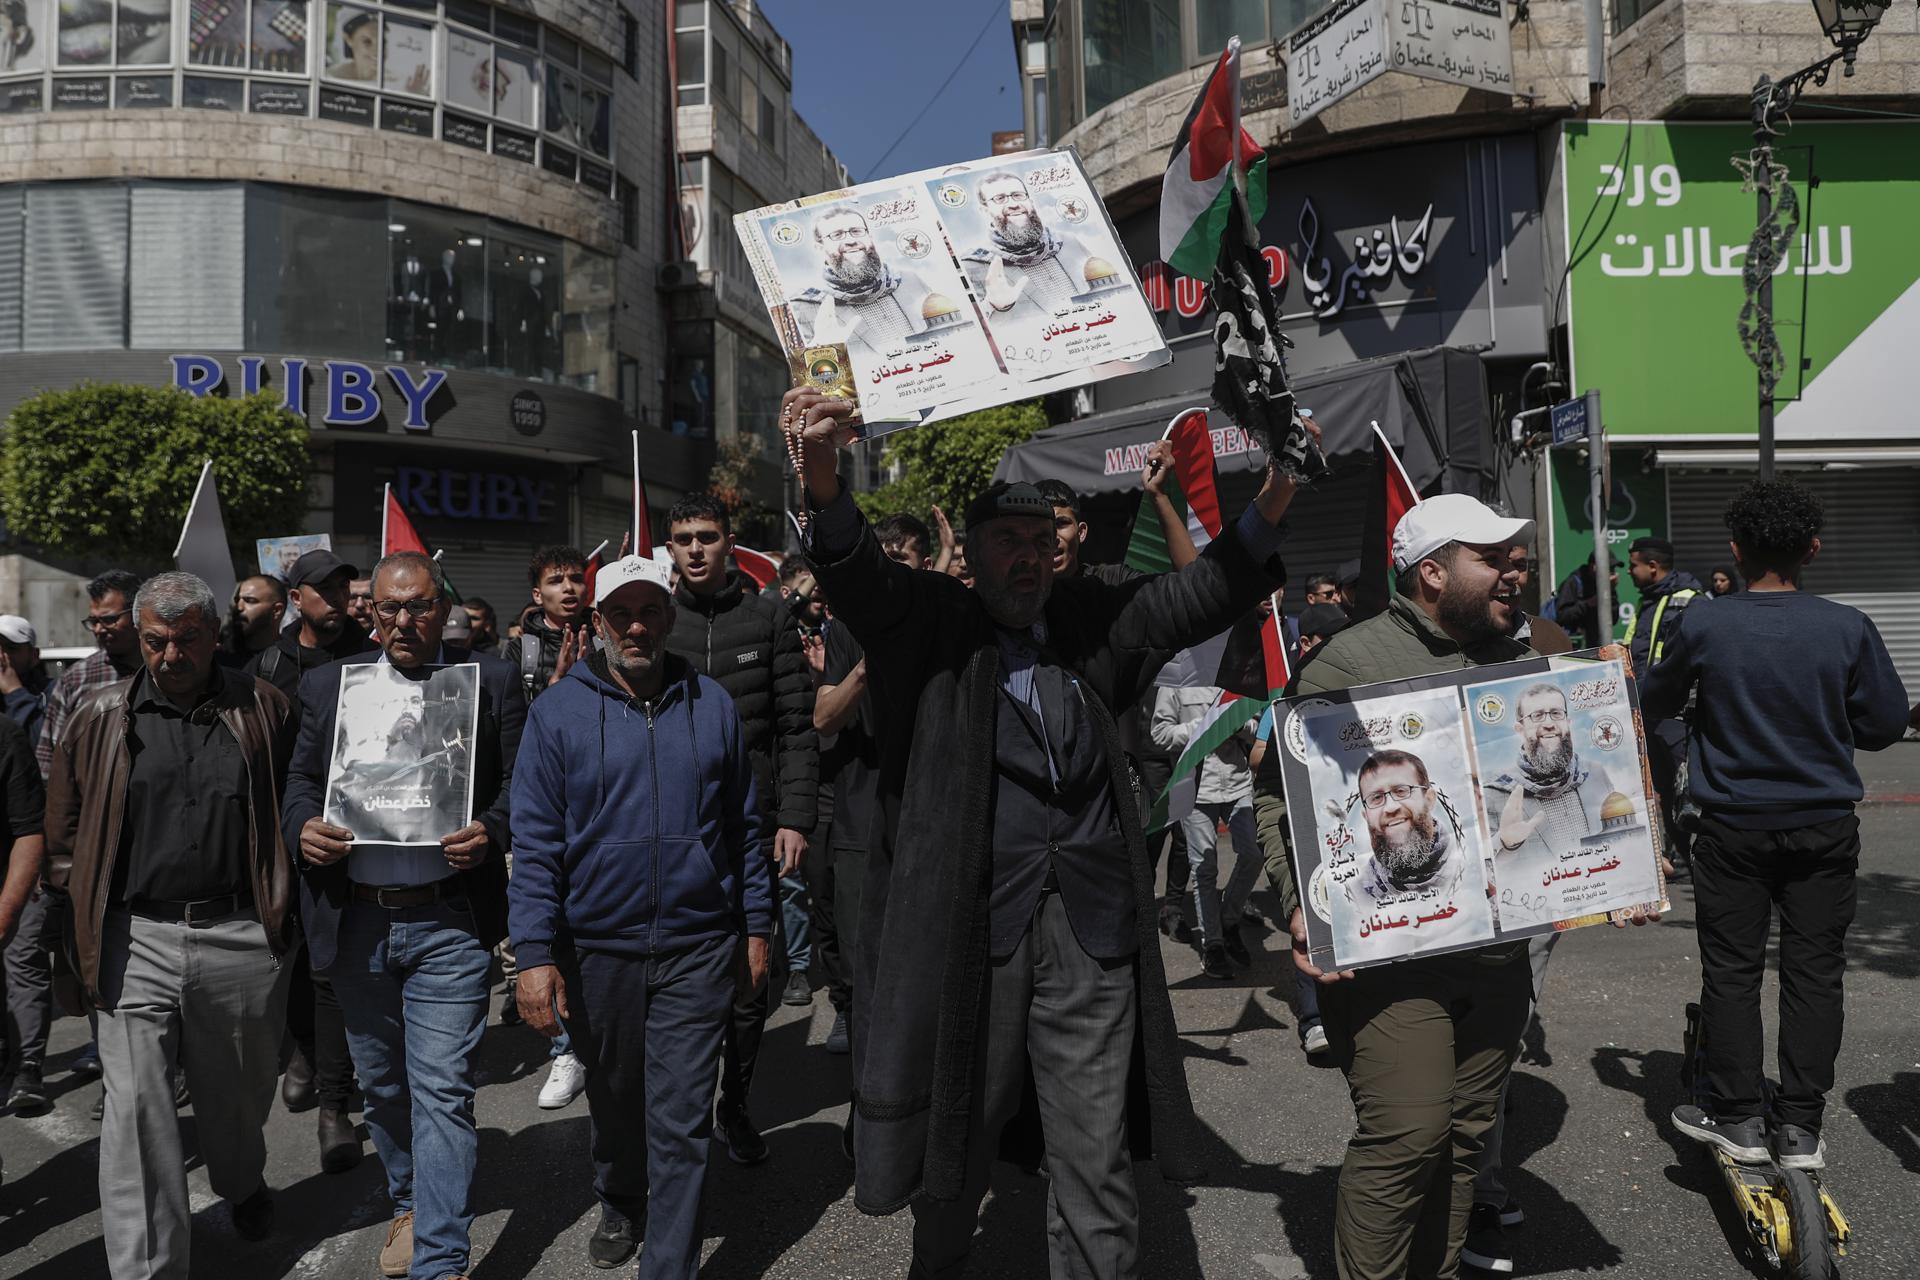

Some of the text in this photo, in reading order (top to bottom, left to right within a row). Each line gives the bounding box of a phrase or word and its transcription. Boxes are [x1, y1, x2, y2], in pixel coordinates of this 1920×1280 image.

[1335, 15, 1373, 58] المحامي
[1453, 26, 1495, 41] المحامي
[1354, 49, 1382, 81] منذر
[1395, 41, 1511, 84] منذر شريف عثمان
[1322, 66, 1353, 99] شريف
[1292, 87, 1320, 121] عثمان
[1597, 163, 1682, 207] ورد
[1041, 310, 1117, 342] خضر عدنان
[871, 350, 954, 384] خضر عدنان
[169, 354, 448, 430] RUBY
[397, 465, 548, 523] RUBY
[736, 650, 759, 665] TERREX
[401, 794, 432, 812] خضر
[1331, 868, 1360, 884] الحرية
[1542, 855, 1621, 887] خضر عدنان
[1376, 896, 1397, 909] الشيخ
[1359, 901, 1459, 938] خضر عدنان
